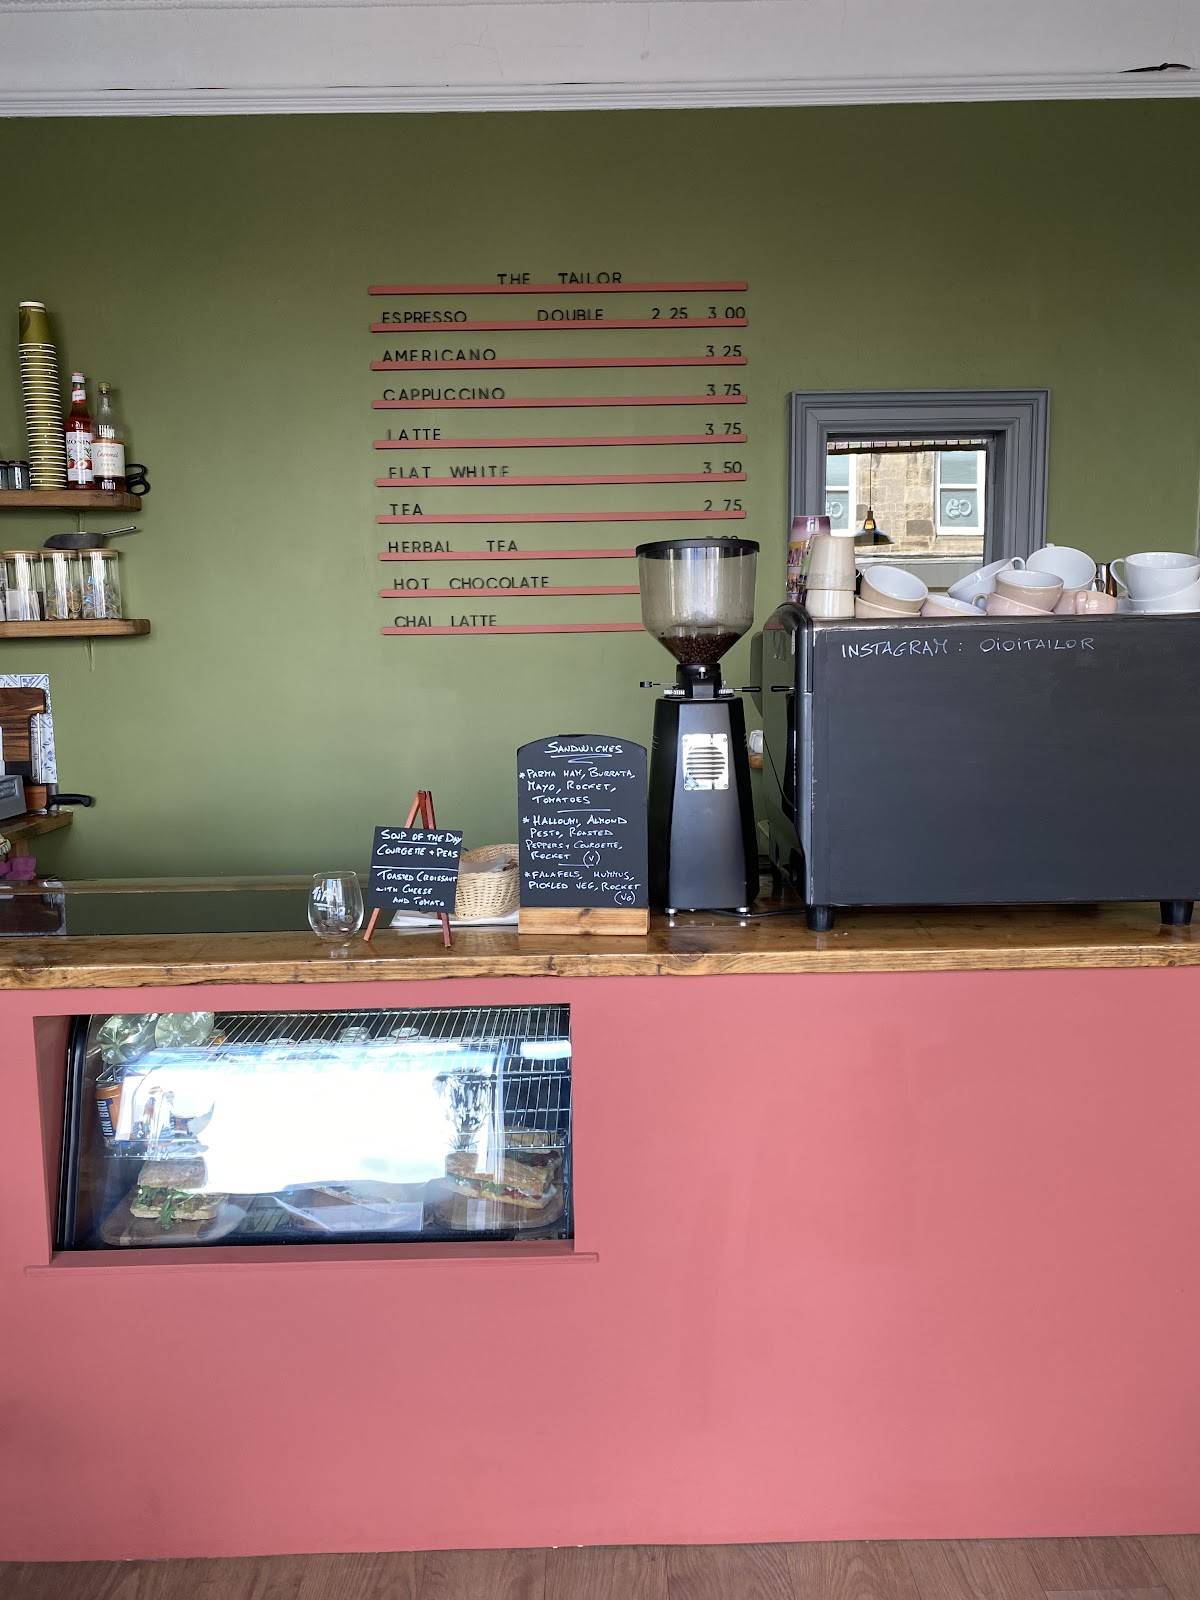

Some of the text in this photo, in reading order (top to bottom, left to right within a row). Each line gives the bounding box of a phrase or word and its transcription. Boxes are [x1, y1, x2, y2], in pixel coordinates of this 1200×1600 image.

[497, 272, 622, 284] THE TAILOR
[382, 311, 467, 323] ESPRESSO
[537, 309, 604, 321] DOUBLE
[382, 348, 496, 362] AMERICANO
[383, 388, 505, 401] CAPPUCCINO
[450, 466, 509, 478] WHITE
[389, 504, 423, 516] TEA
[388, 540, 518, 553] HERBAL TEA
[394, 576, 549, 590] HOT CHOCOLATE
[394, 615, 496, 627] CHAI LATTE
[544, 741, 623, 753] SANDWICHES
[532, 795, 590, 804] TOMATOES
[381, 830, 407, 840] SOUP
[446, 833, 462, 845] DAY
[436, 848, 458, 858] PEAS
[531, 851, 570, 860] ROCKET
[529, 881, 568, 890] PICKLED
[601, 882, 641, 892] ROCKET
